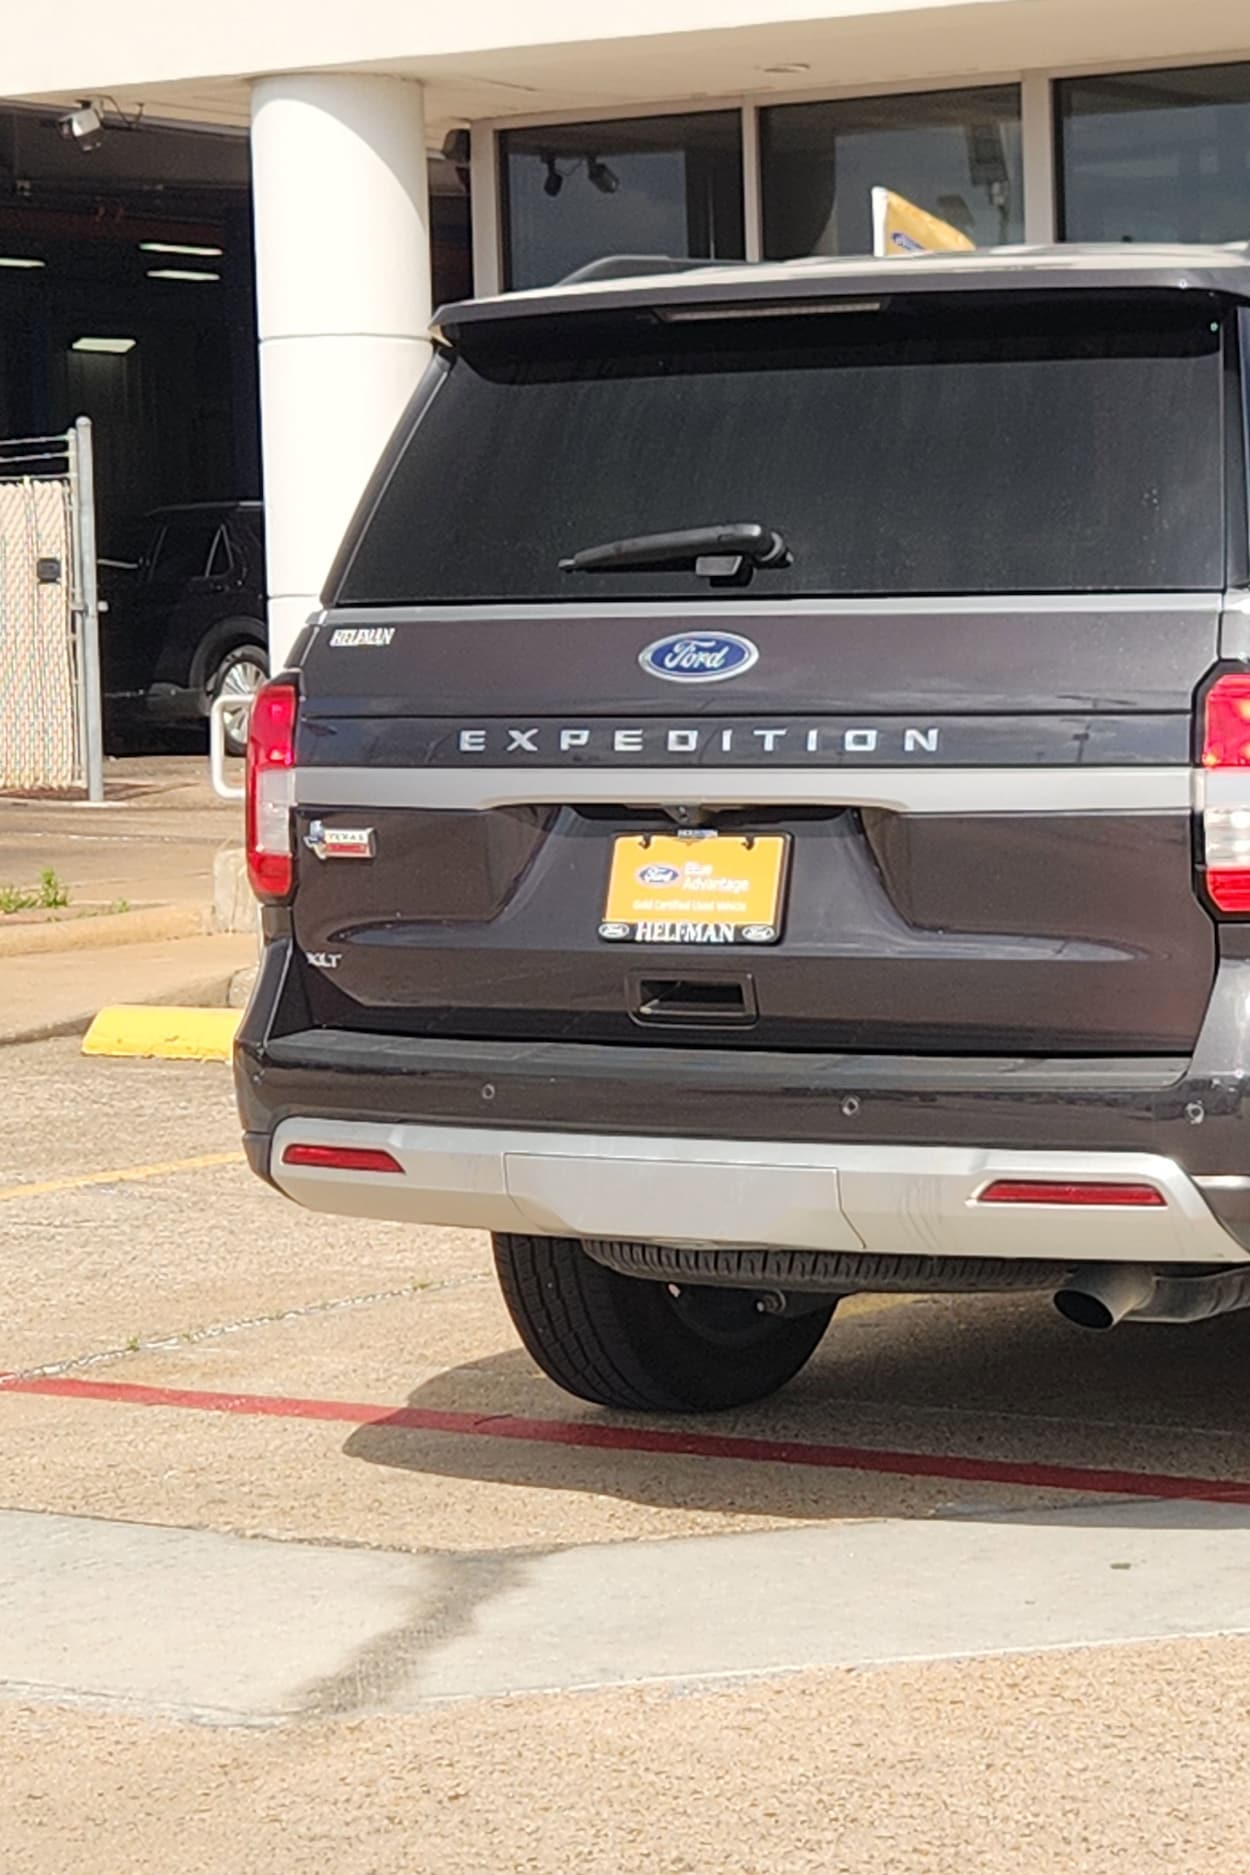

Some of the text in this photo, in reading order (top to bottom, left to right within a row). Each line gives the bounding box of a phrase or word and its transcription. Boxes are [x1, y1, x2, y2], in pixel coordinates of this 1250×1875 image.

[663, 639, 730, 669] Ford
[459, 728, 940, 752] EXPEDITION
[327, 832, 365, 841] TEXAS
[634, 921, 736, 943] HELFMAN
[305, 951, 343, 968] XLT
